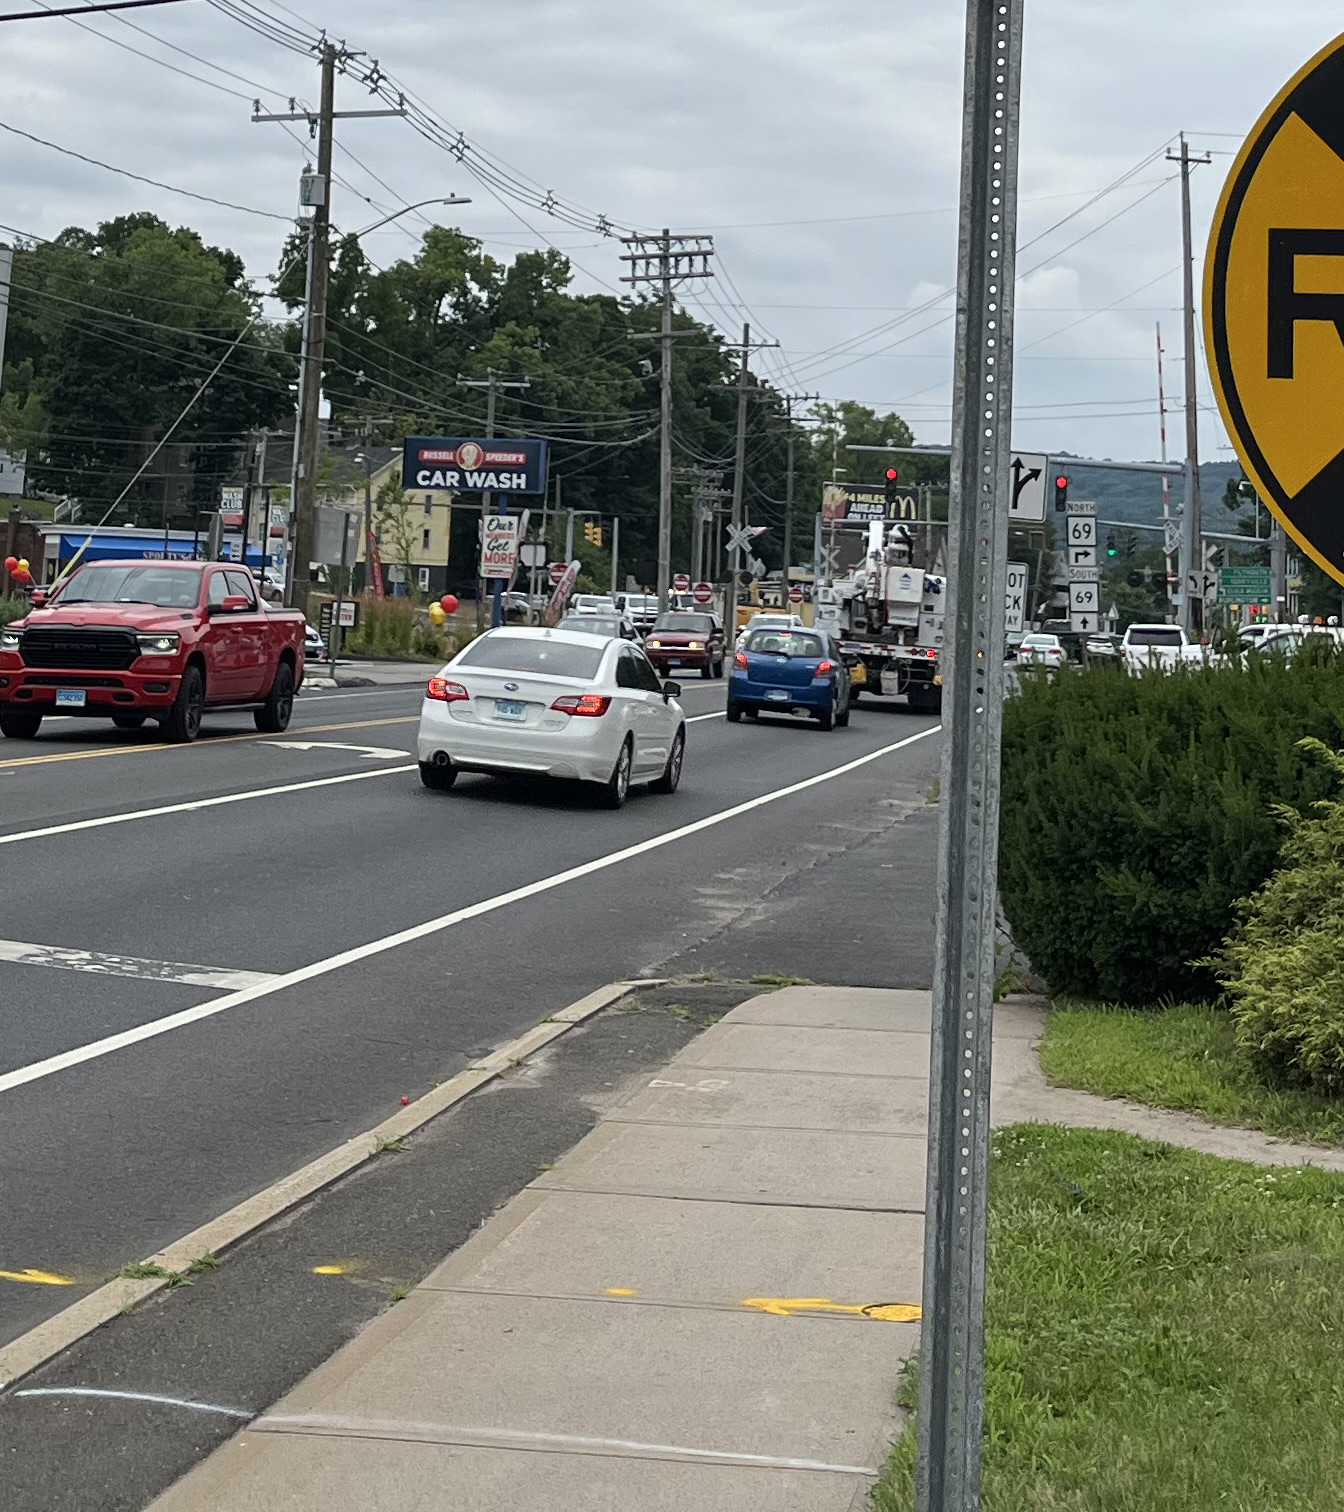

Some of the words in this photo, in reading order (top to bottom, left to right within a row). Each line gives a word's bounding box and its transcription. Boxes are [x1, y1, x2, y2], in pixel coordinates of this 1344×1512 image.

[416, 469, 460, 487] CAR
[465, 471, 527, 489] WASH
[1067, 502, 1096, 513] NORTH
[487, 516, 514, 532] Our
[1072, 522, 1092, 540] 69
[487, 538, 510, 552] Get
[483, 552, 515, 564] MORE
[1007, 572, 1025, 589] OT
[1069, 568, 1097, 579] SOUTH
[1075, 591, 1093, 604] 69
